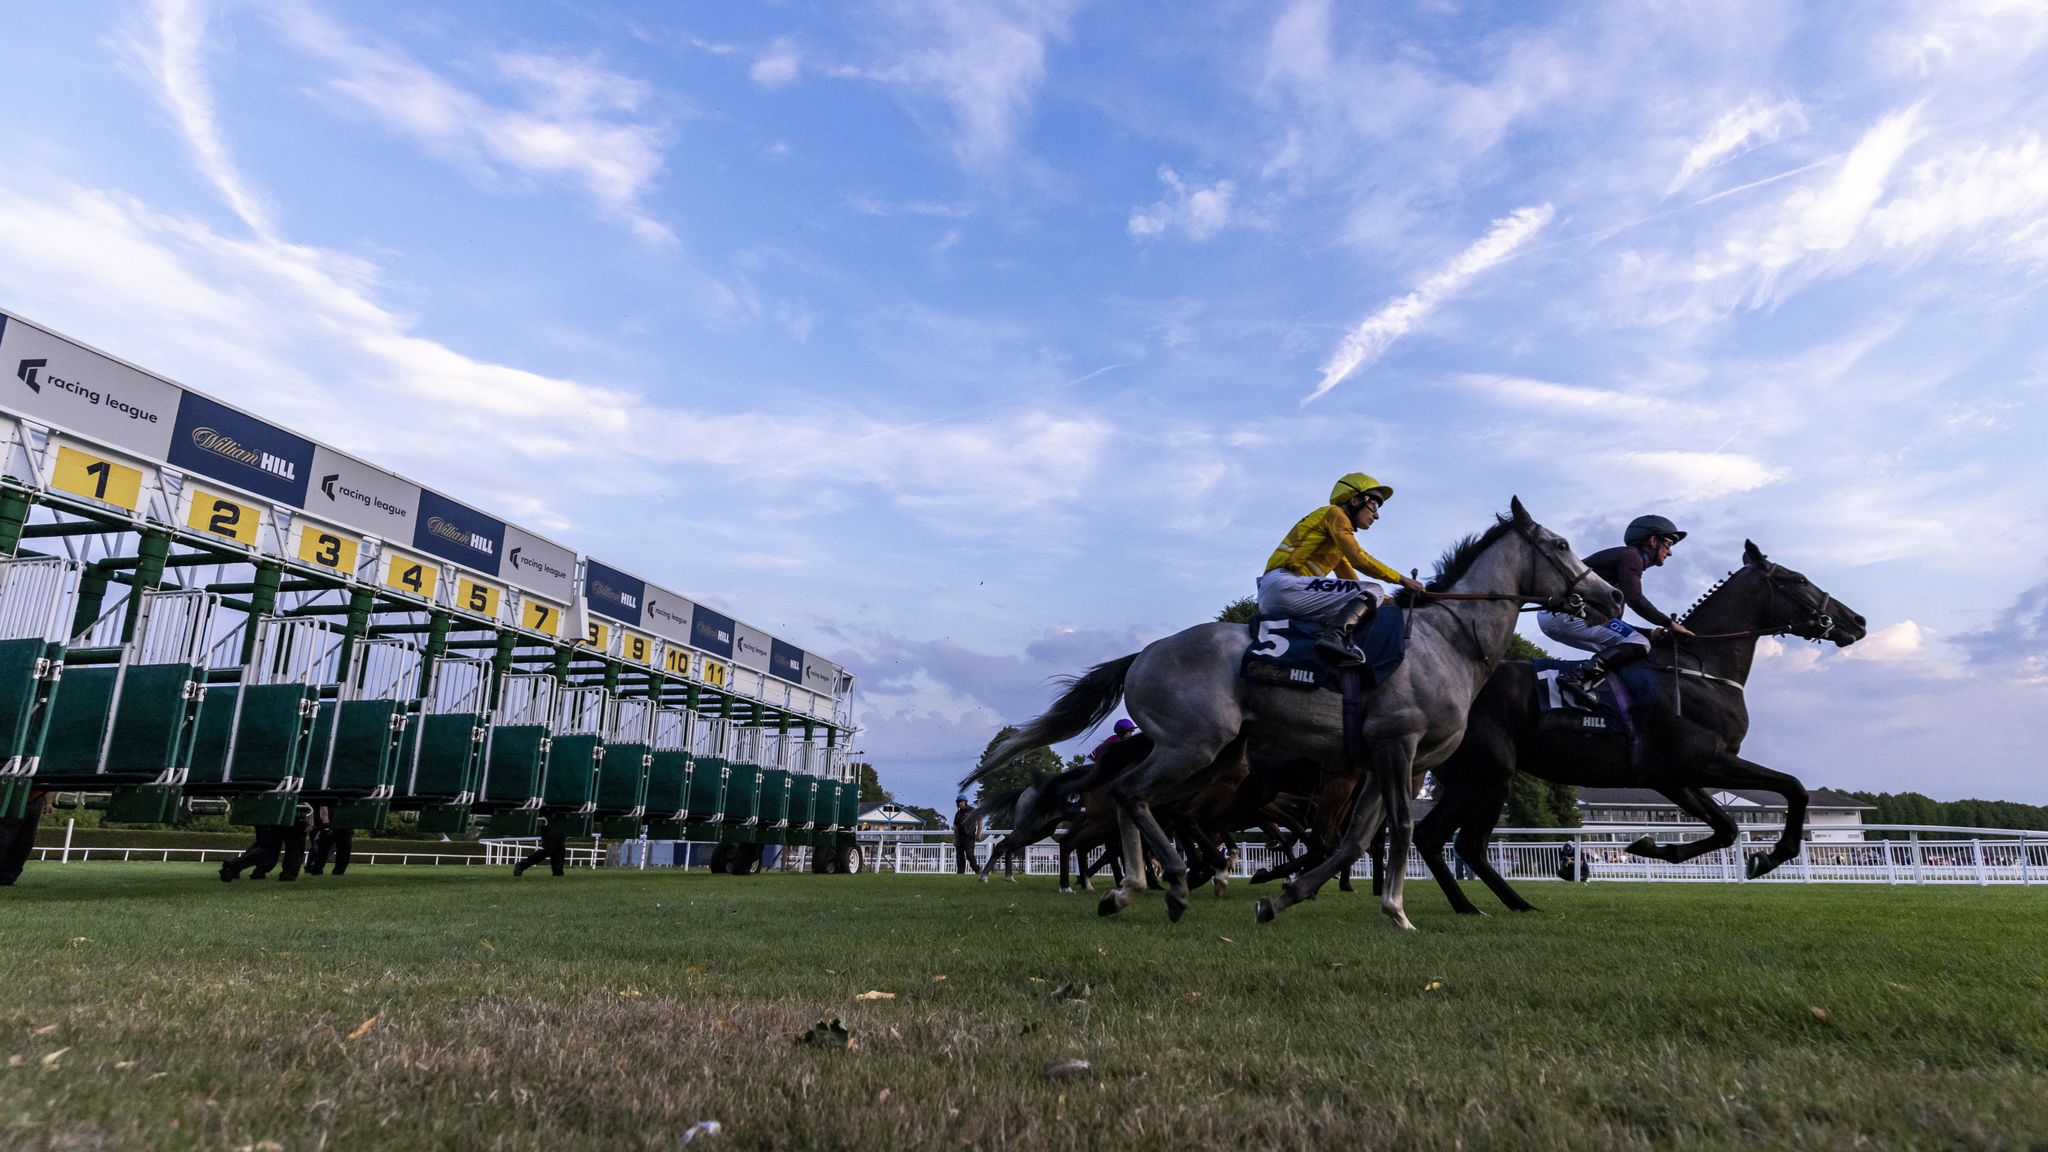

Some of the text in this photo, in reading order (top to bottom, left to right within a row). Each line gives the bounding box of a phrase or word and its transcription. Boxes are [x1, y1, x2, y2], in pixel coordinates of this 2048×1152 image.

[47, 374, 158, 423] racing league
[192, 427, 295, 480] William HILL
[86, 462, 110, 499] 1
[339, 485, 407, 517] racing league
[208, 500, 240, 538] 2
[427, 516, 494, 555] William HILL
[316, 534, 341, 568] 3
[402, 564, 424, 593] 4
[521, 556, 567, 579] racing league
[469, 584, 488, 612] 5
[620, 592, 637, 609] HILL
[534, 605, 549, 629] 7
[632, 638, 644, 660] 9
[1252, 619, 1290, 657] 5
[669, 650, 688, 674] 10
[708, 663, 723, 685] 11
[1289, 669, 1315, 684] HILL
[1583, 716, 1607, 728] HILL
